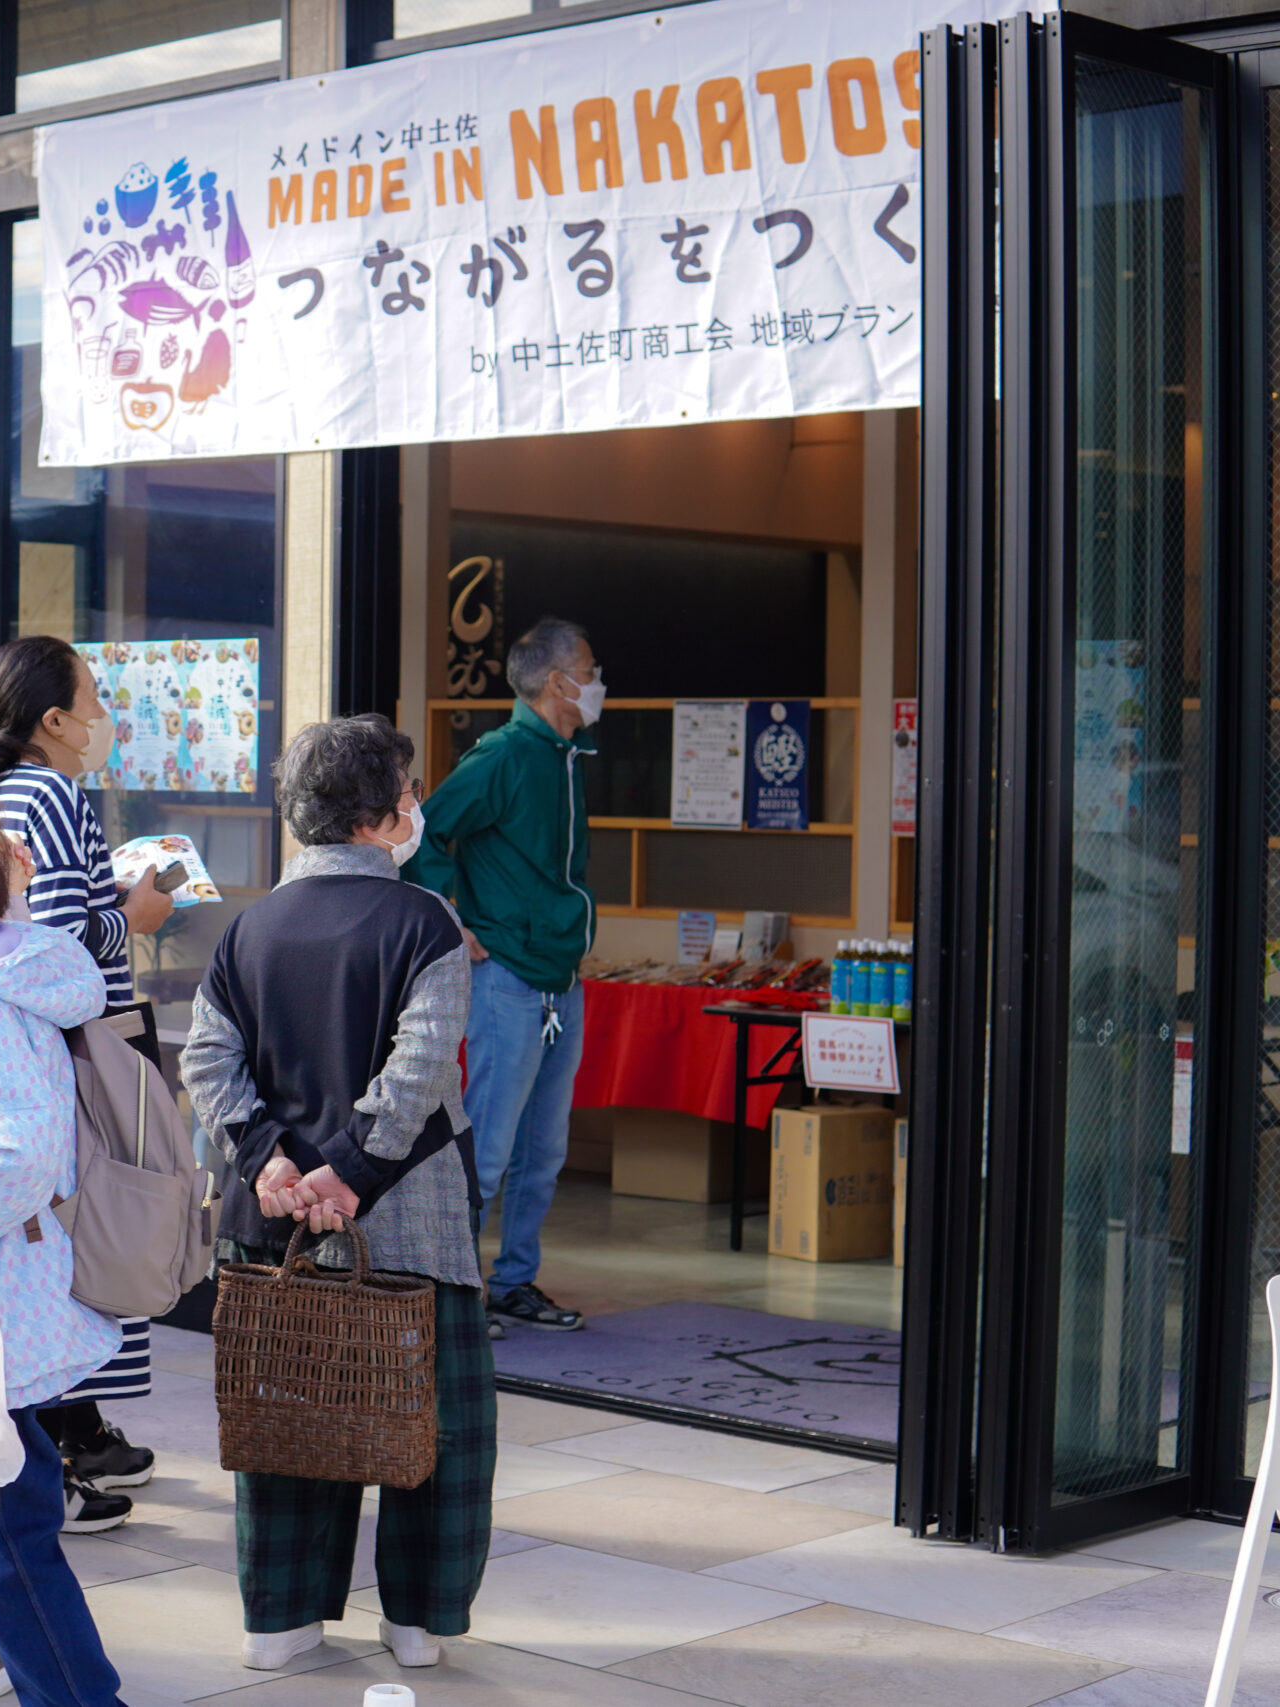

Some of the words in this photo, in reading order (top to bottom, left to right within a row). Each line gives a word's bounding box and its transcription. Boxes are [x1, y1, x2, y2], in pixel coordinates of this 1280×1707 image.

[270, 113, 479, 171] メイドイン中土佐
[267, 156, 411, 230] MADE
[433, 145, 484, 207] IN
[470, 345, 499, 378] by
[511, 317, 734, 373] 中土佐町商工会
[749, 303, 916, 349] 地域ブラン
[559, 1369, 840, 1424] COLLETTO
[662, 1375, 800, 1402] AGRI
